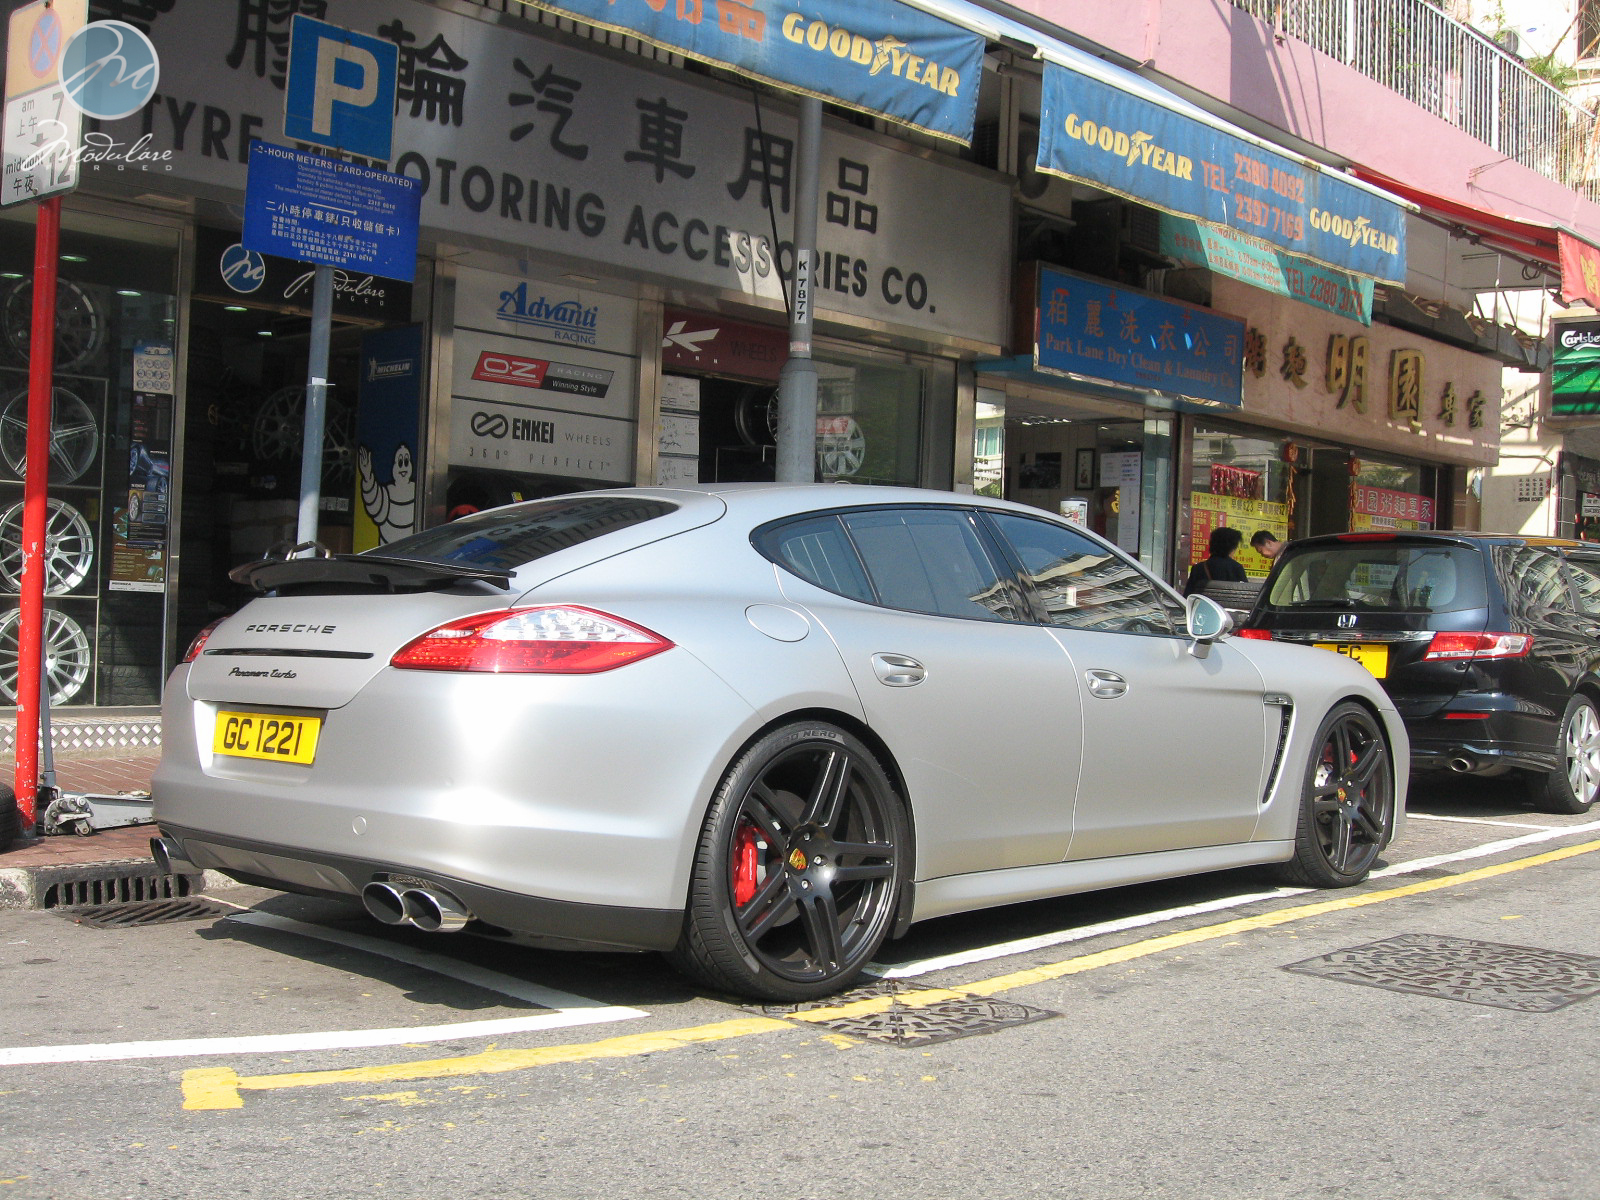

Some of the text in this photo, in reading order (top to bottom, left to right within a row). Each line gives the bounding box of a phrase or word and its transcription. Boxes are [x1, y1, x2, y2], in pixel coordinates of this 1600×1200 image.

[782, 12, 959, 97] GOODYEAR
[312, 36, 379, 136] P
[22, 99, 35, 113] am
[52, 91, 66, 126] 7
[16, 116, 38, 138] 上午
[1064, 113, 1194, 181] GOODYEAR
[5, 150, 44, 175] midnight
[49, 148, 71, 187] 12
[296, 154, 332, 169] METERS
[13, 175, 34, 196] 午夜
[1234, 153, 1270, 190] 2380
[1271, 163, 1305, 203] 4092
[142, 93, 263, 165] TYRE
[352, 152, 606, 238] OTORING
[881, 266, 936, 313] CO.
[1235, 193, 1270, 227] 2397
[1310, 207, 1398, 255] GOODYEAR
[304, 287, 385, 306] FRGED
[796, 261, 809, 320] K 7877
[497, 281, 599, 328] Advanti
[554, 330, 596, 345] RACING
[1560, 330, 1600, 348] Carlsbe
[730, 341, 777, 362] WHEELS
[1046, 333, 1073, 354] Park
[1077, 339, 1104, 360] Lane
[1108, 346, 1128, 369] Dry
[1130, 352, 1161, 373] Clean
[1165, 360, 1173, 376] &
[1176, 361, 1220, 388] Laundry
[377, 362, 411, 374] MICHELIN
[557, 367, 603, 380] RACING
[552, 380, 597, 393] Winning Style
[512, 418, 611, 447] ENKEI WHEELS
[246, 624, 337, 634] PORSCHE
[228, 667, 297, 679] Panamera turbo
[223, 717, 303, 757] GC 1221
